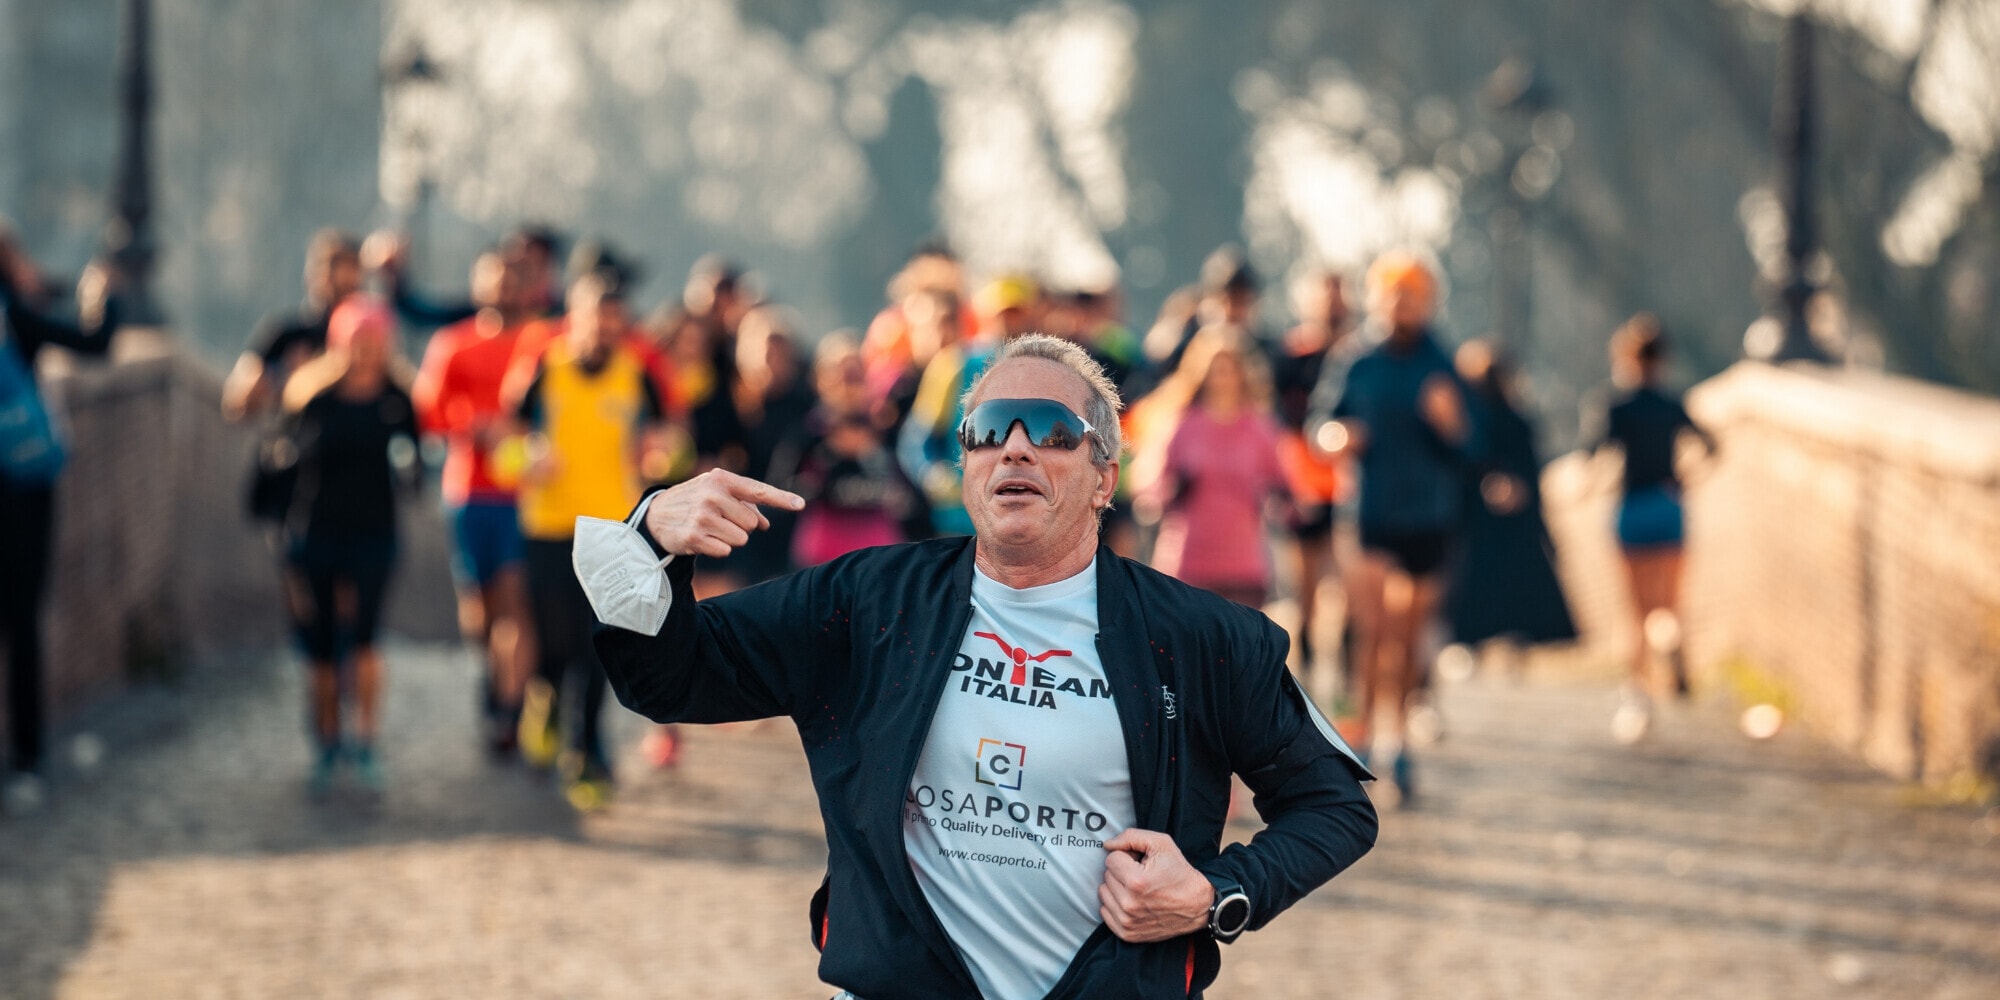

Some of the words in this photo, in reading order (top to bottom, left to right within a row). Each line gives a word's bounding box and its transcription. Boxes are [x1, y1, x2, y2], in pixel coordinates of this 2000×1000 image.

[960, 676, 1057, 710] ITALIA
[989, 754, 1011, 775] C
[941, 817, 988, 837] Quality
[991, 823, 1047, 846] Delivery
[1050, 834, 1063, 846] di
[1067, 835, 1104, 849] Roma
[938, 846, 1048, 871] www.cosaporto.it
